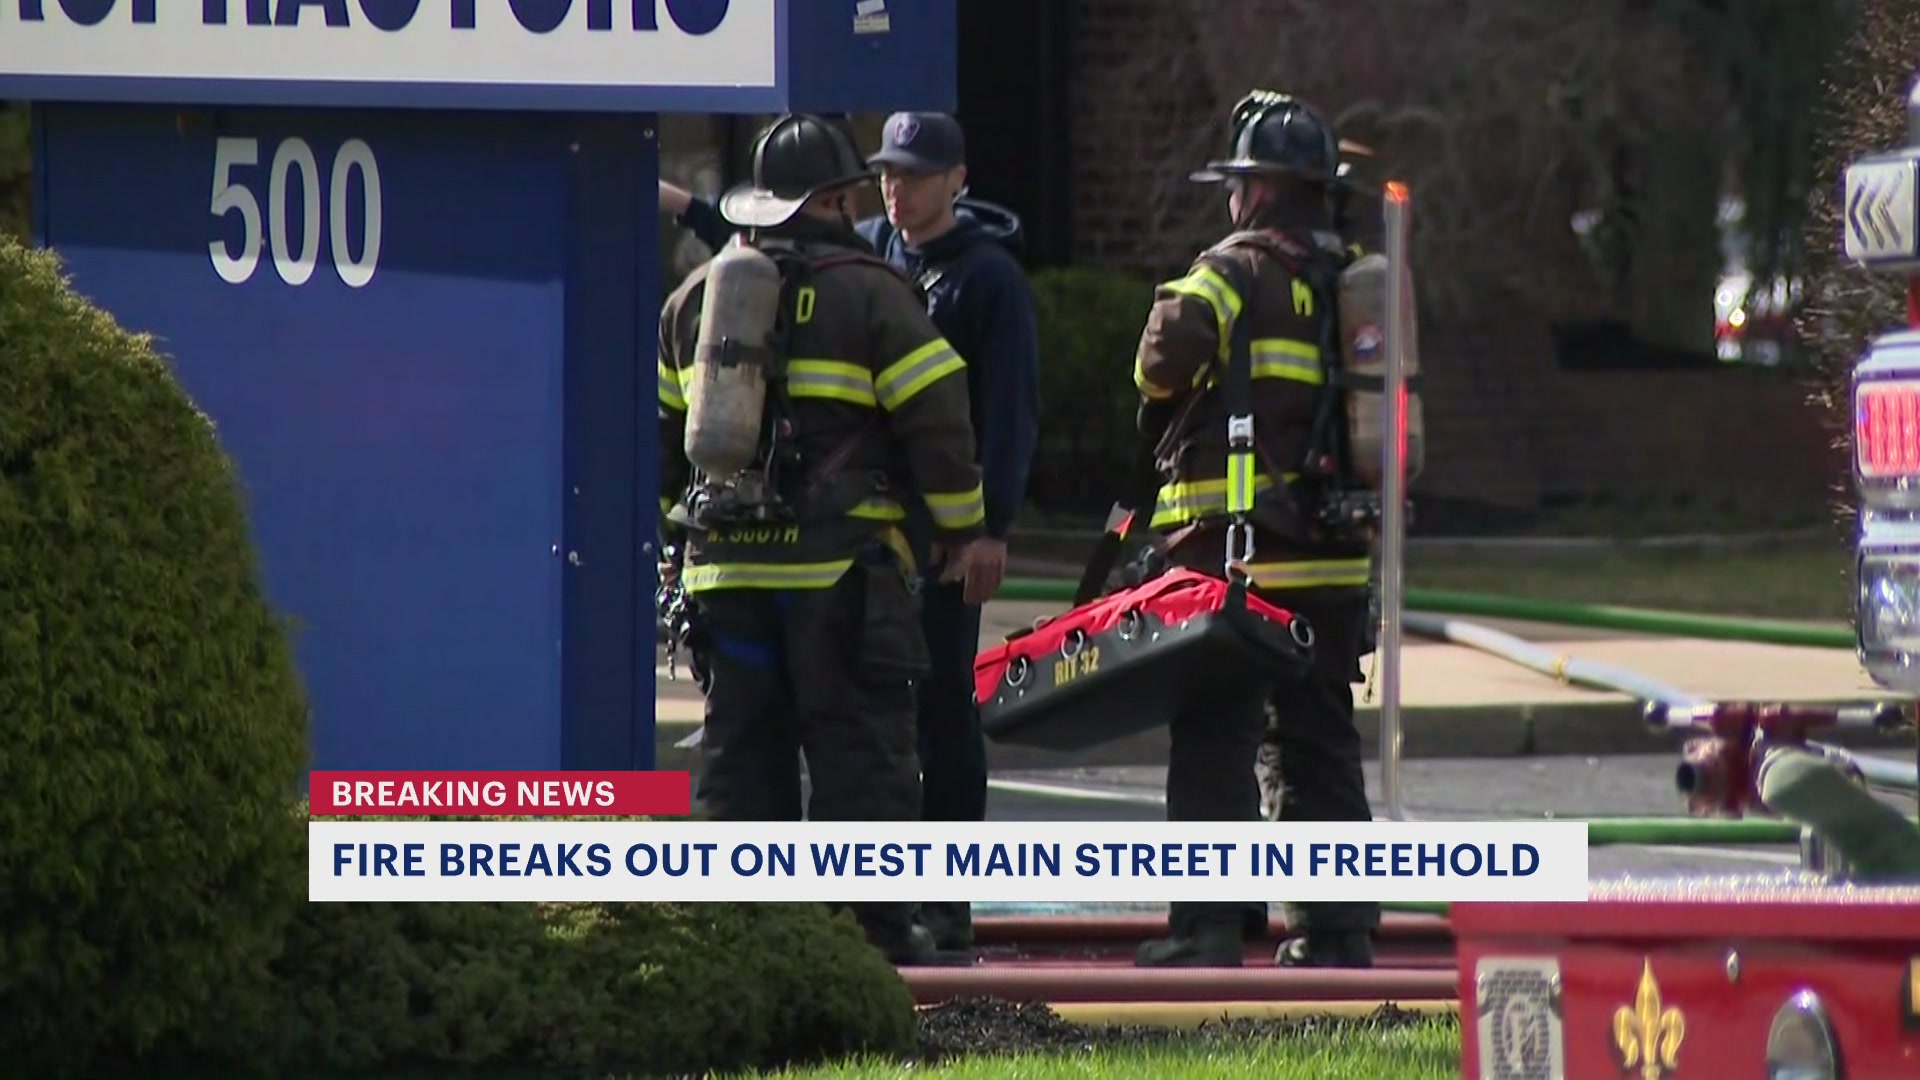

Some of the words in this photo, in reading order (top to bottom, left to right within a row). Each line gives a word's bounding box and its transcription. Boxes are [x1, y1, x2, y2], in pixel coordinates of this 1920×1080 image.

[208, 136, 382, 289] 500
[1054, 657, 1077, 687] RIT
[1080, 646, 1100, 674] 32
